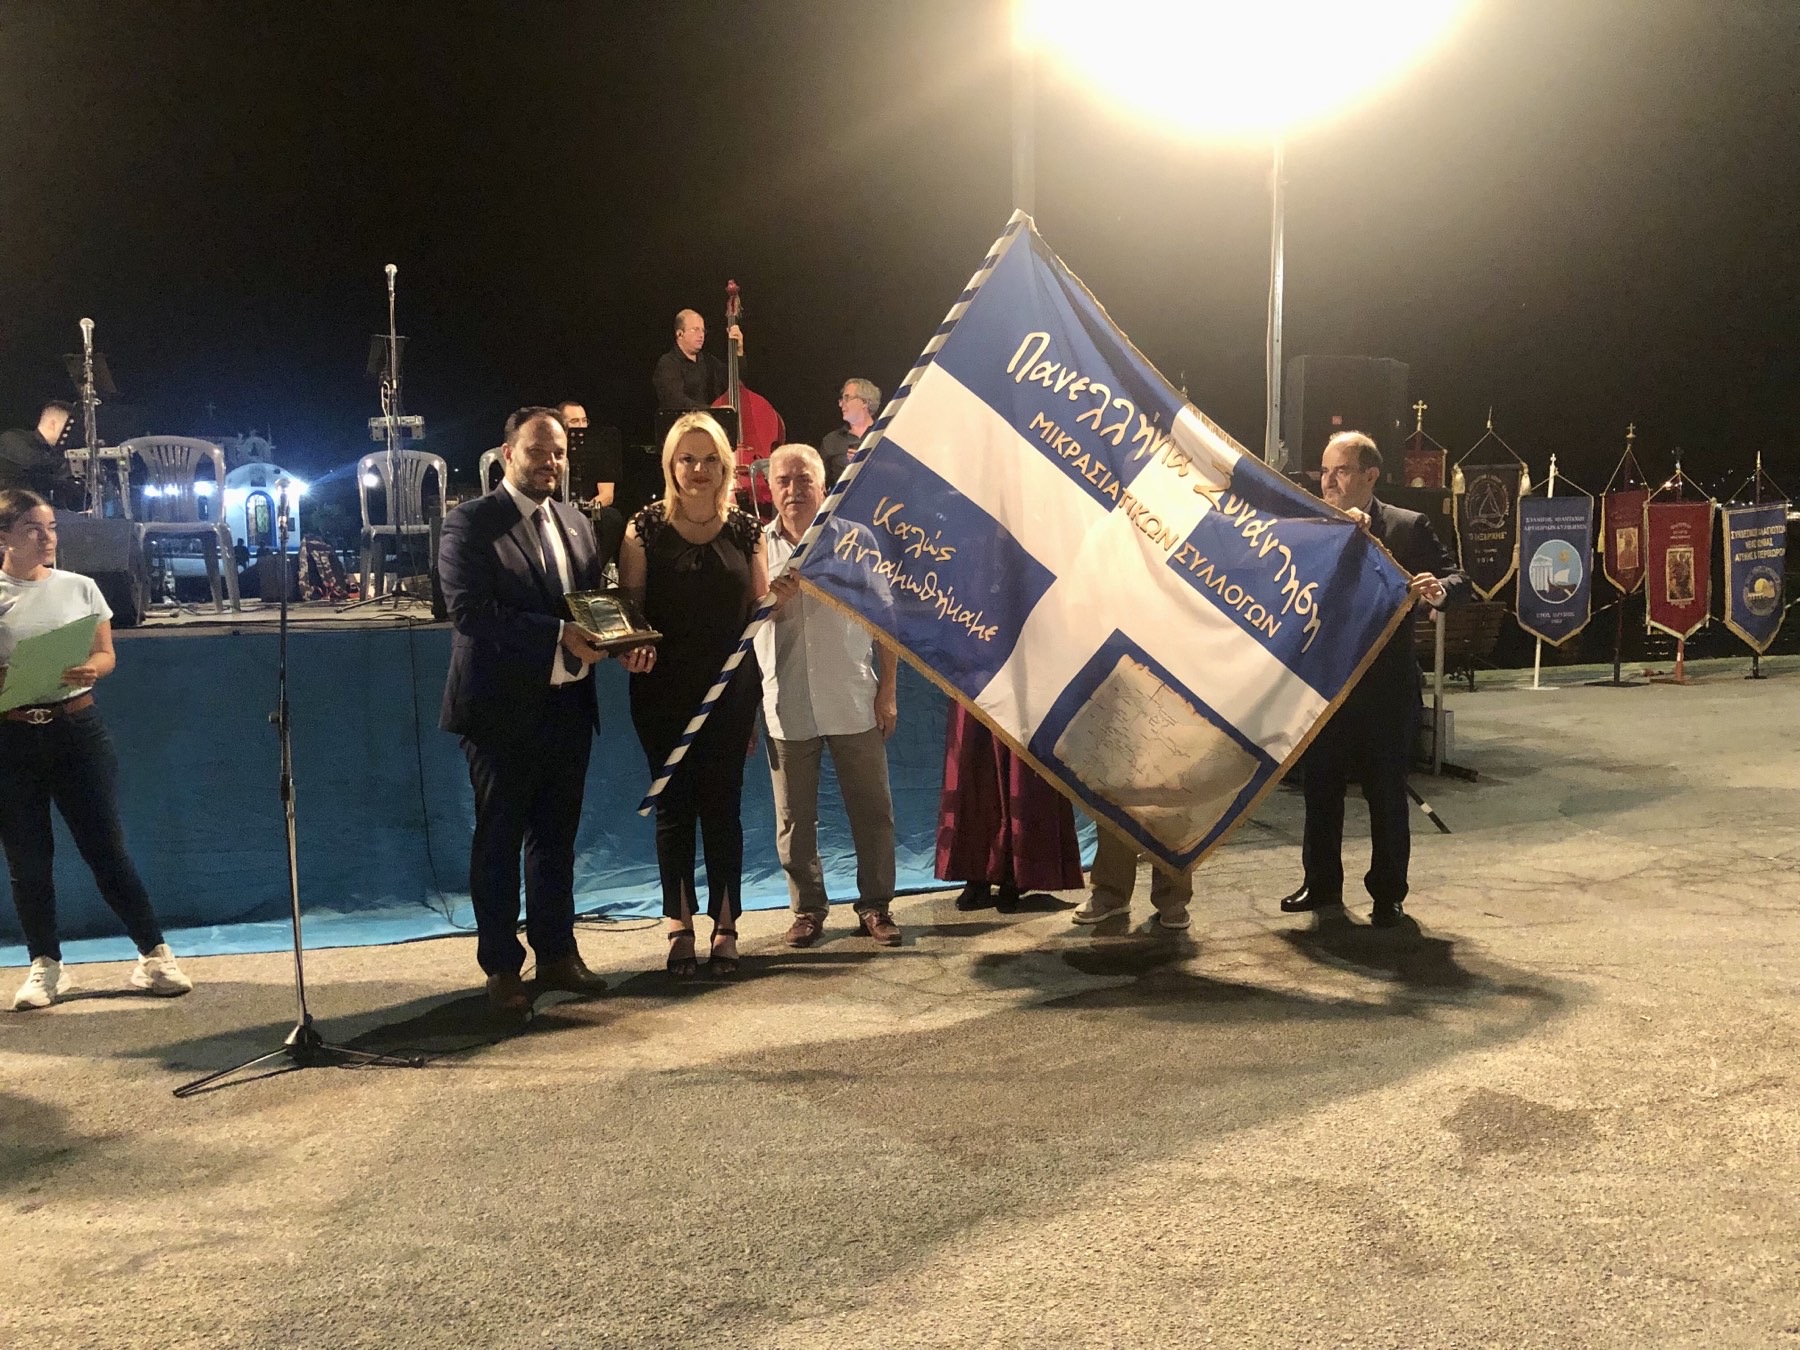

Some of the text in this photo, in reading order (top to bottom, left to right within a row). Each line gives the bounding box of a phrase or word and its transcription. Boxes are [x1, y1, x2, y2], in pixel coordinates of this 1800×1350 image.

[1006, 331, 1193, 477] Πανελλήνια
[873, 496, 956, 561] Καλώς
[1029, 411, 1282, 639] ΜΙΚΡΑΣΙΑΤΙΚΩΝ ΣΥΛΛΟΓΩΝ
